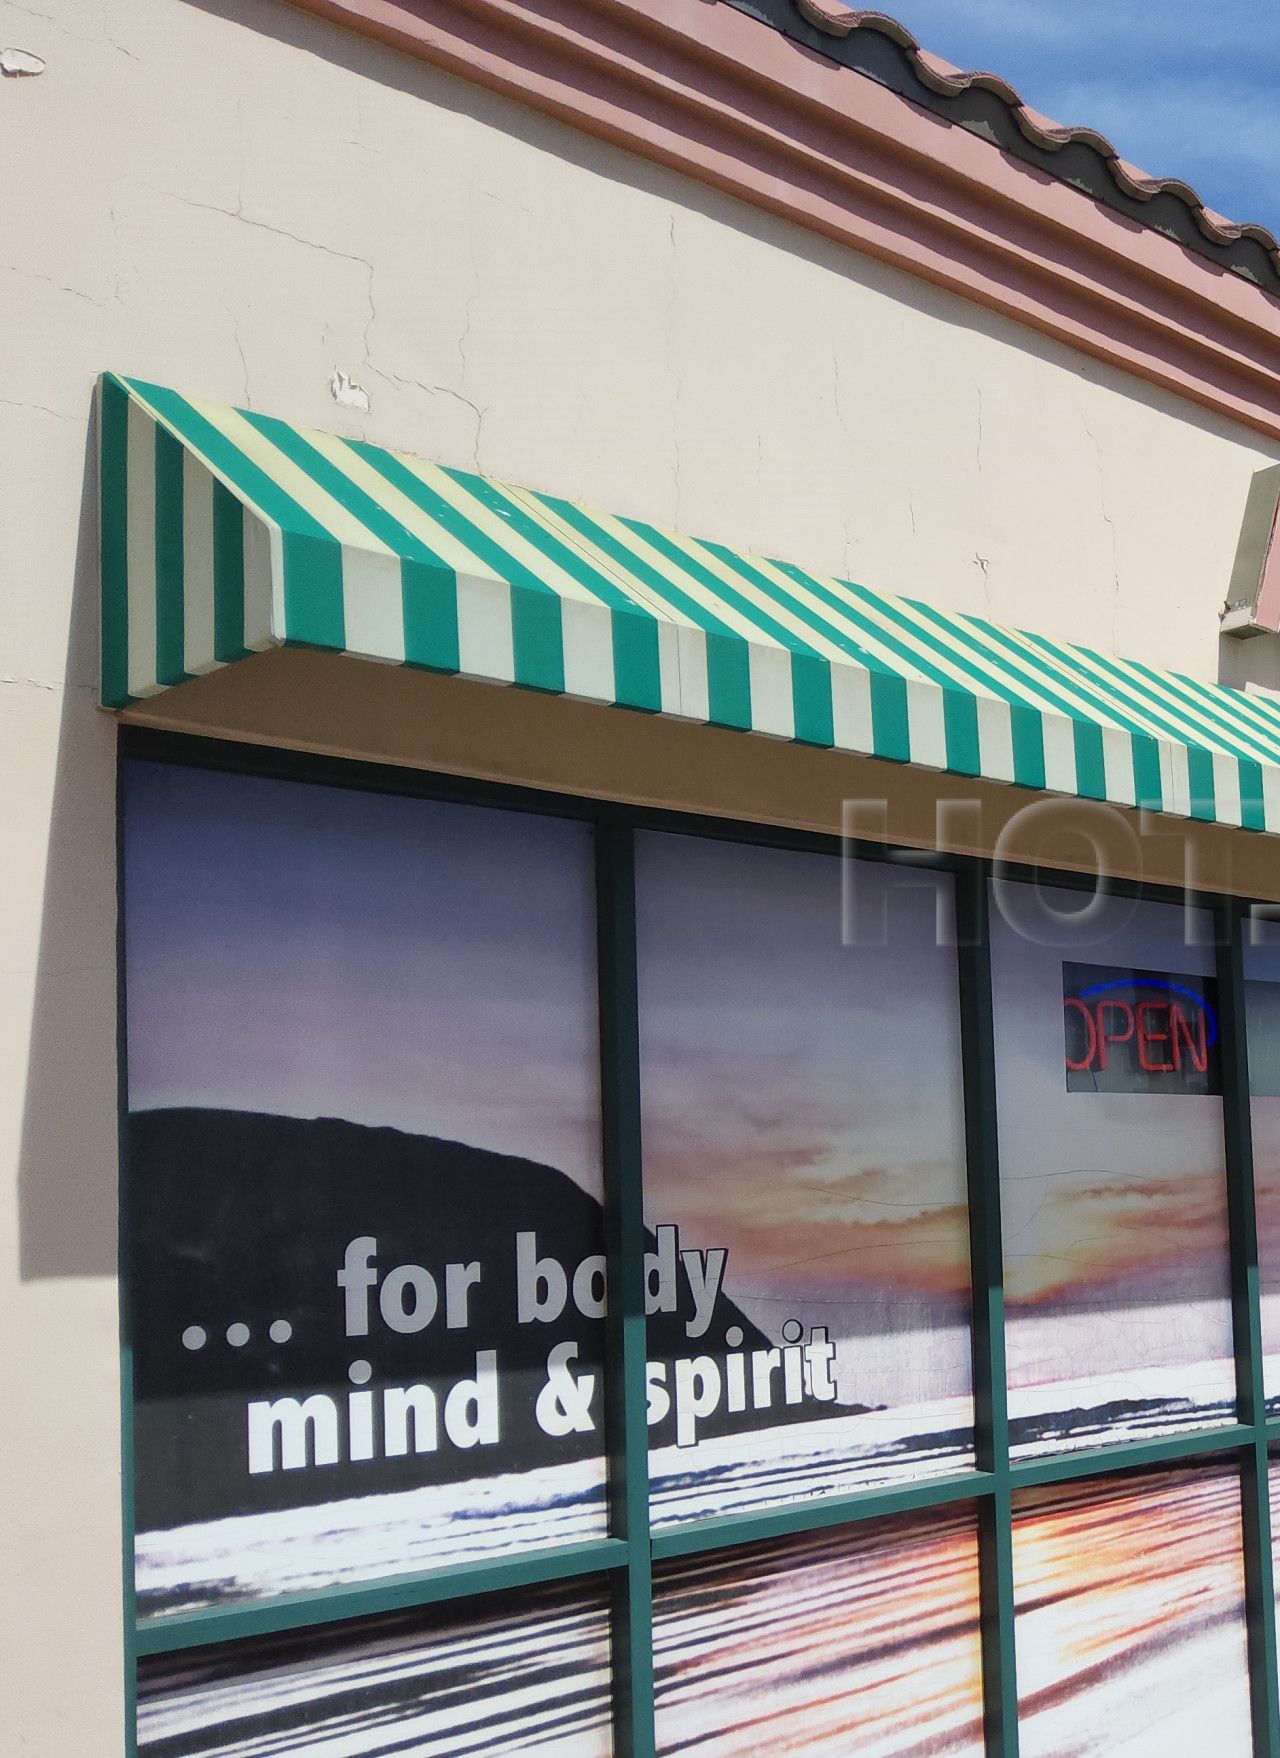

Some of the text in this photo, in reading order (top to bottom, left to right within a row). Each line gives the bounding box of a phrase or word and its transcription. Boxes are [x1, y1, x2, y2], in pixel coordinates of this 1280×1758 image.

[336, 1236, 482, 1337] for
[516, 1224, 730, 1339] body
[247, 1318, 838, 1476] mind & spirit
